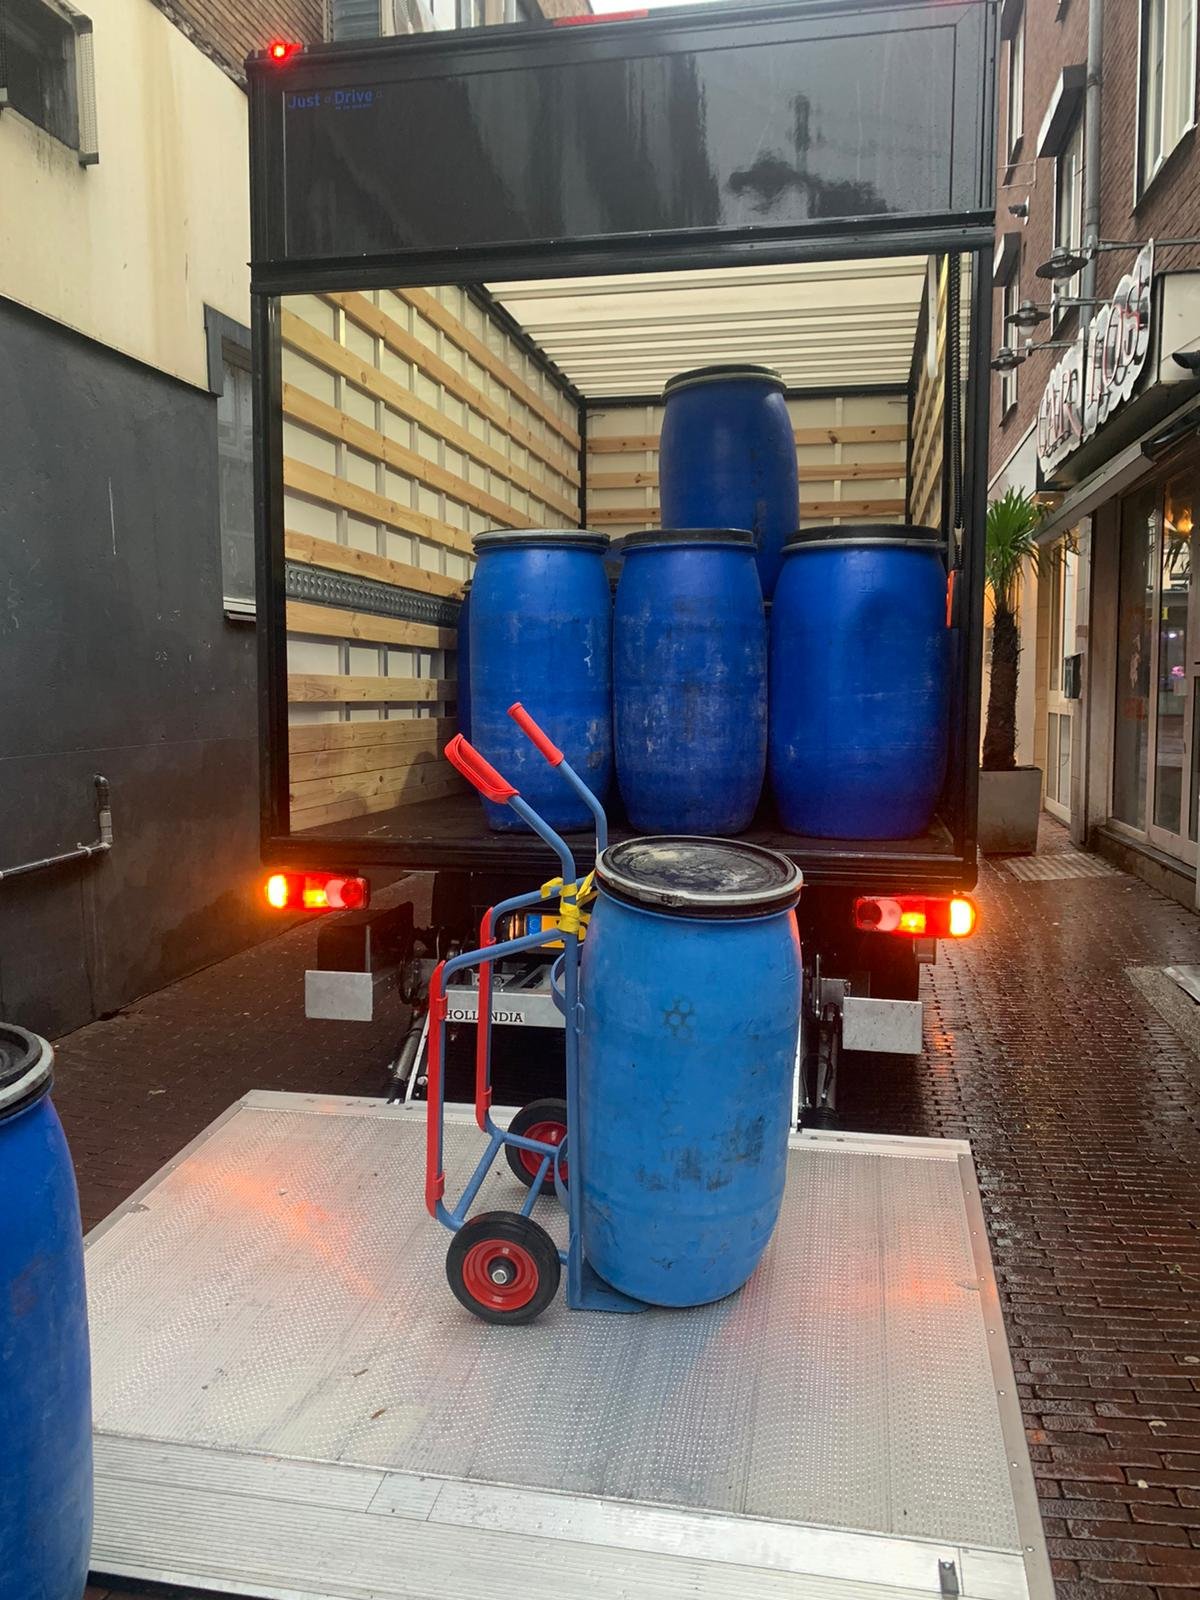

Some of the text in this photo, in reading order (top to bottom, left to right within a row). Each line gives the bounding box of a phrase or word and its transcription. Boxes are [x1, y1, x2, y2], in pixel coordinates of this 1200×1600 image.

[287, 94, 320, 109] Just
[335, 89, 373, 104] Drive
[445, 1009, 523, 1022] HOLLNDIA
